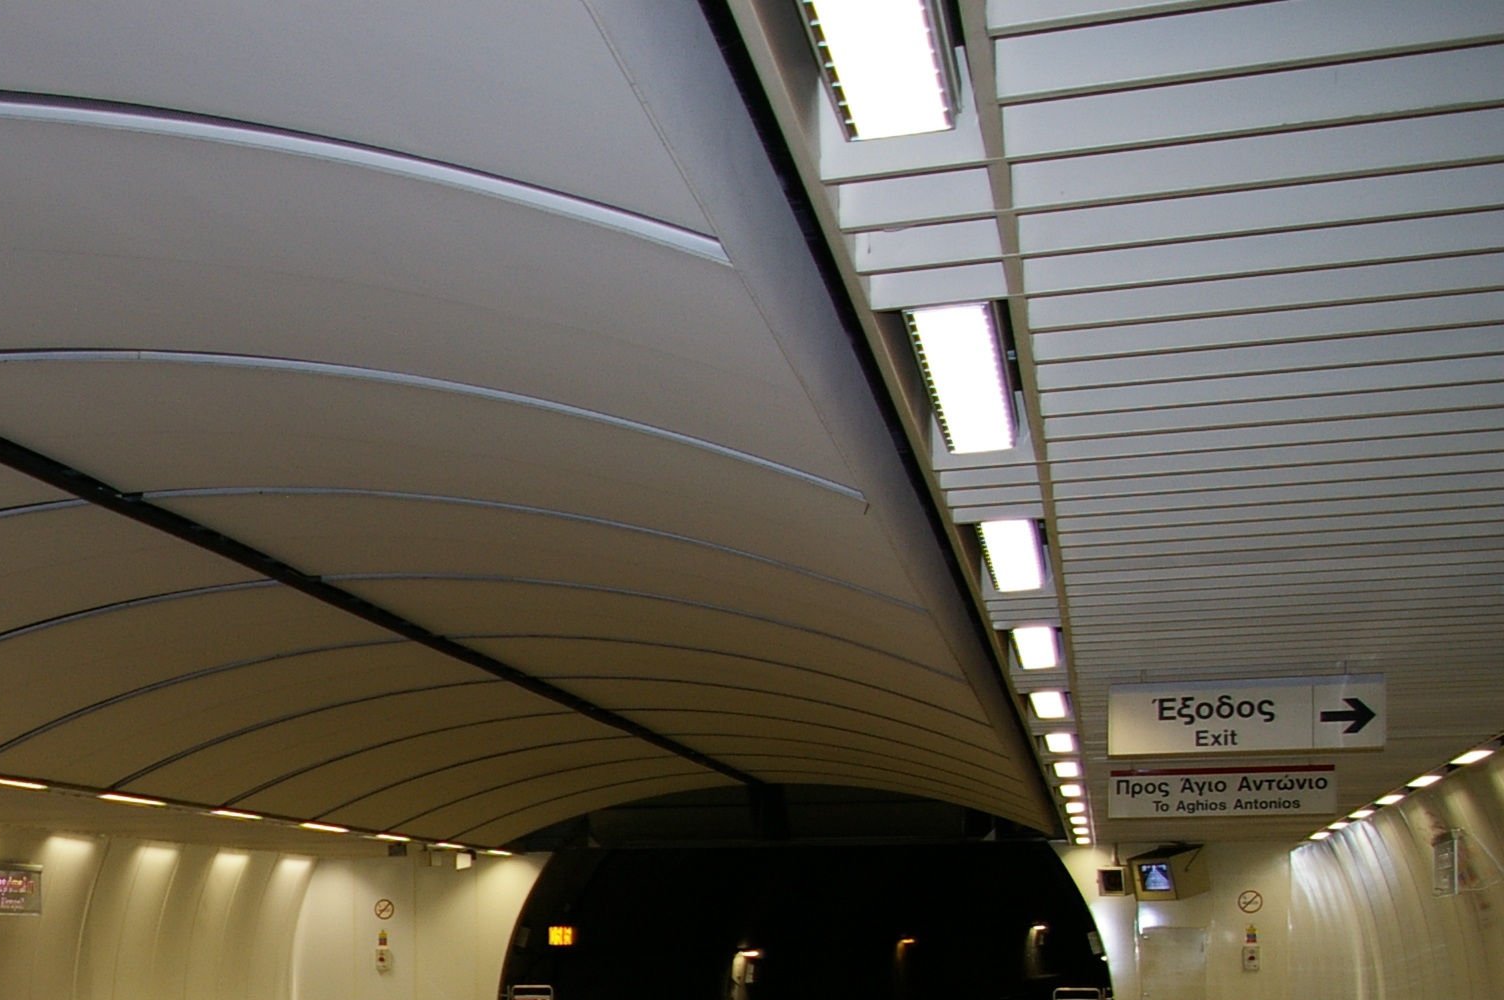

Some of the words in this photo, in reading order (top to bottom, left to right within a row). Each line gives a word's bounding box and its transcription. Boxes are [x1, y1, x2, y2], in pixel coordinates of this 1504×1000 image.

[1152, 694, 1276, 726] Έξοδος
[1195, 729, 1238, 747] Exit
[1116, 778, 1170, 798] Προς
[1180, 776, 1227, 796] Άγιο
[1237, 773, 1328, 793] Αντώνιο
[1153, 800, 1170, 812] To
[1176, 799, 1227, 814] Aghios
[1233, 797, 1301, 811] Antonios
